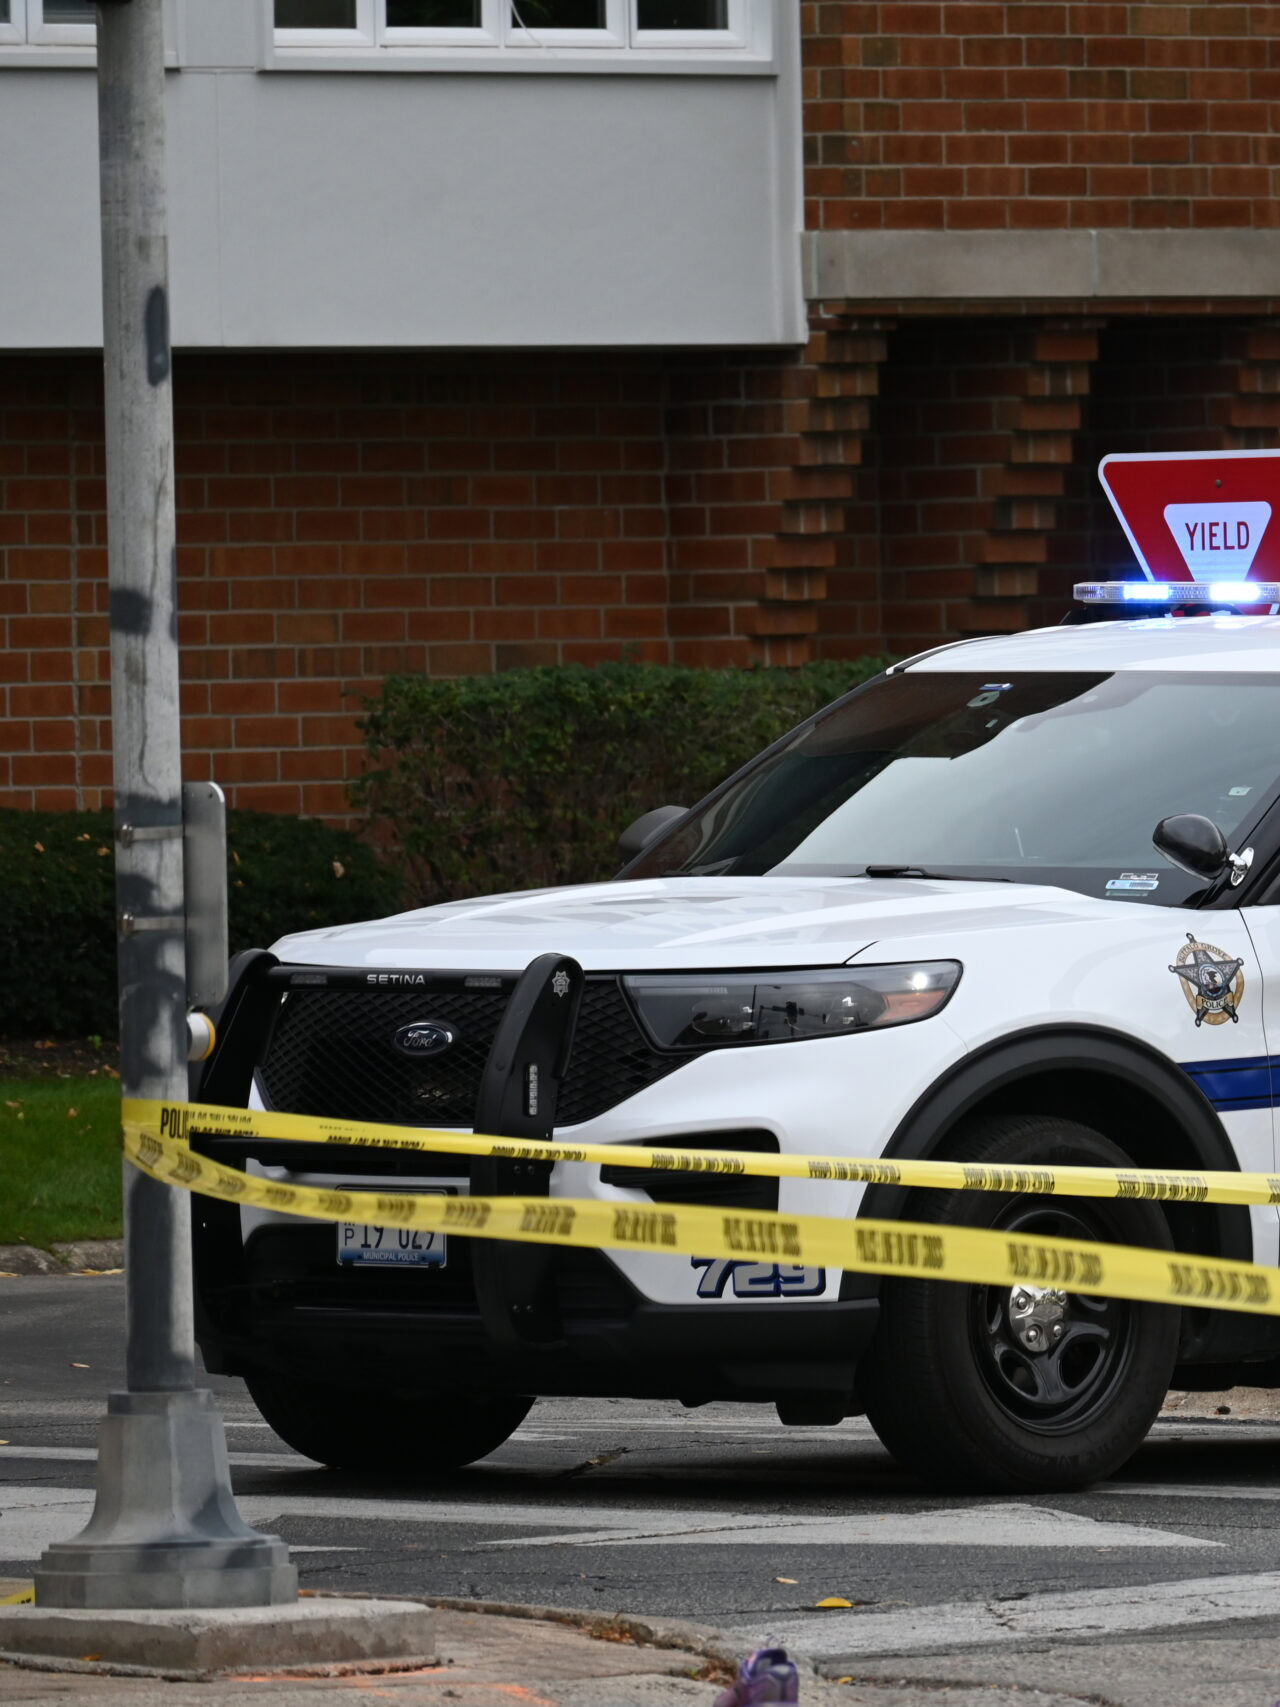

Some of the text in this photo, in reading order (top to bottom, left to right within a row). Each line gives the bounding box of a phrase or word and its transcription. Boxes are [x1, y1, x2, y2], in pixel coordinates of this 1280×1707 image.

[1185, 521, 1250, 551] YIELD
[366, 974, 426, 985] SETINA
[1201, 998, 1228, 1009] POLICE
[403, 1029, 436, 1048] Ford
[344, 1228, 355, 1246] P
[363, 1250, 419, 1261] MUNICIPAL POLICE
[690, 1256, 826, 1298] 729
